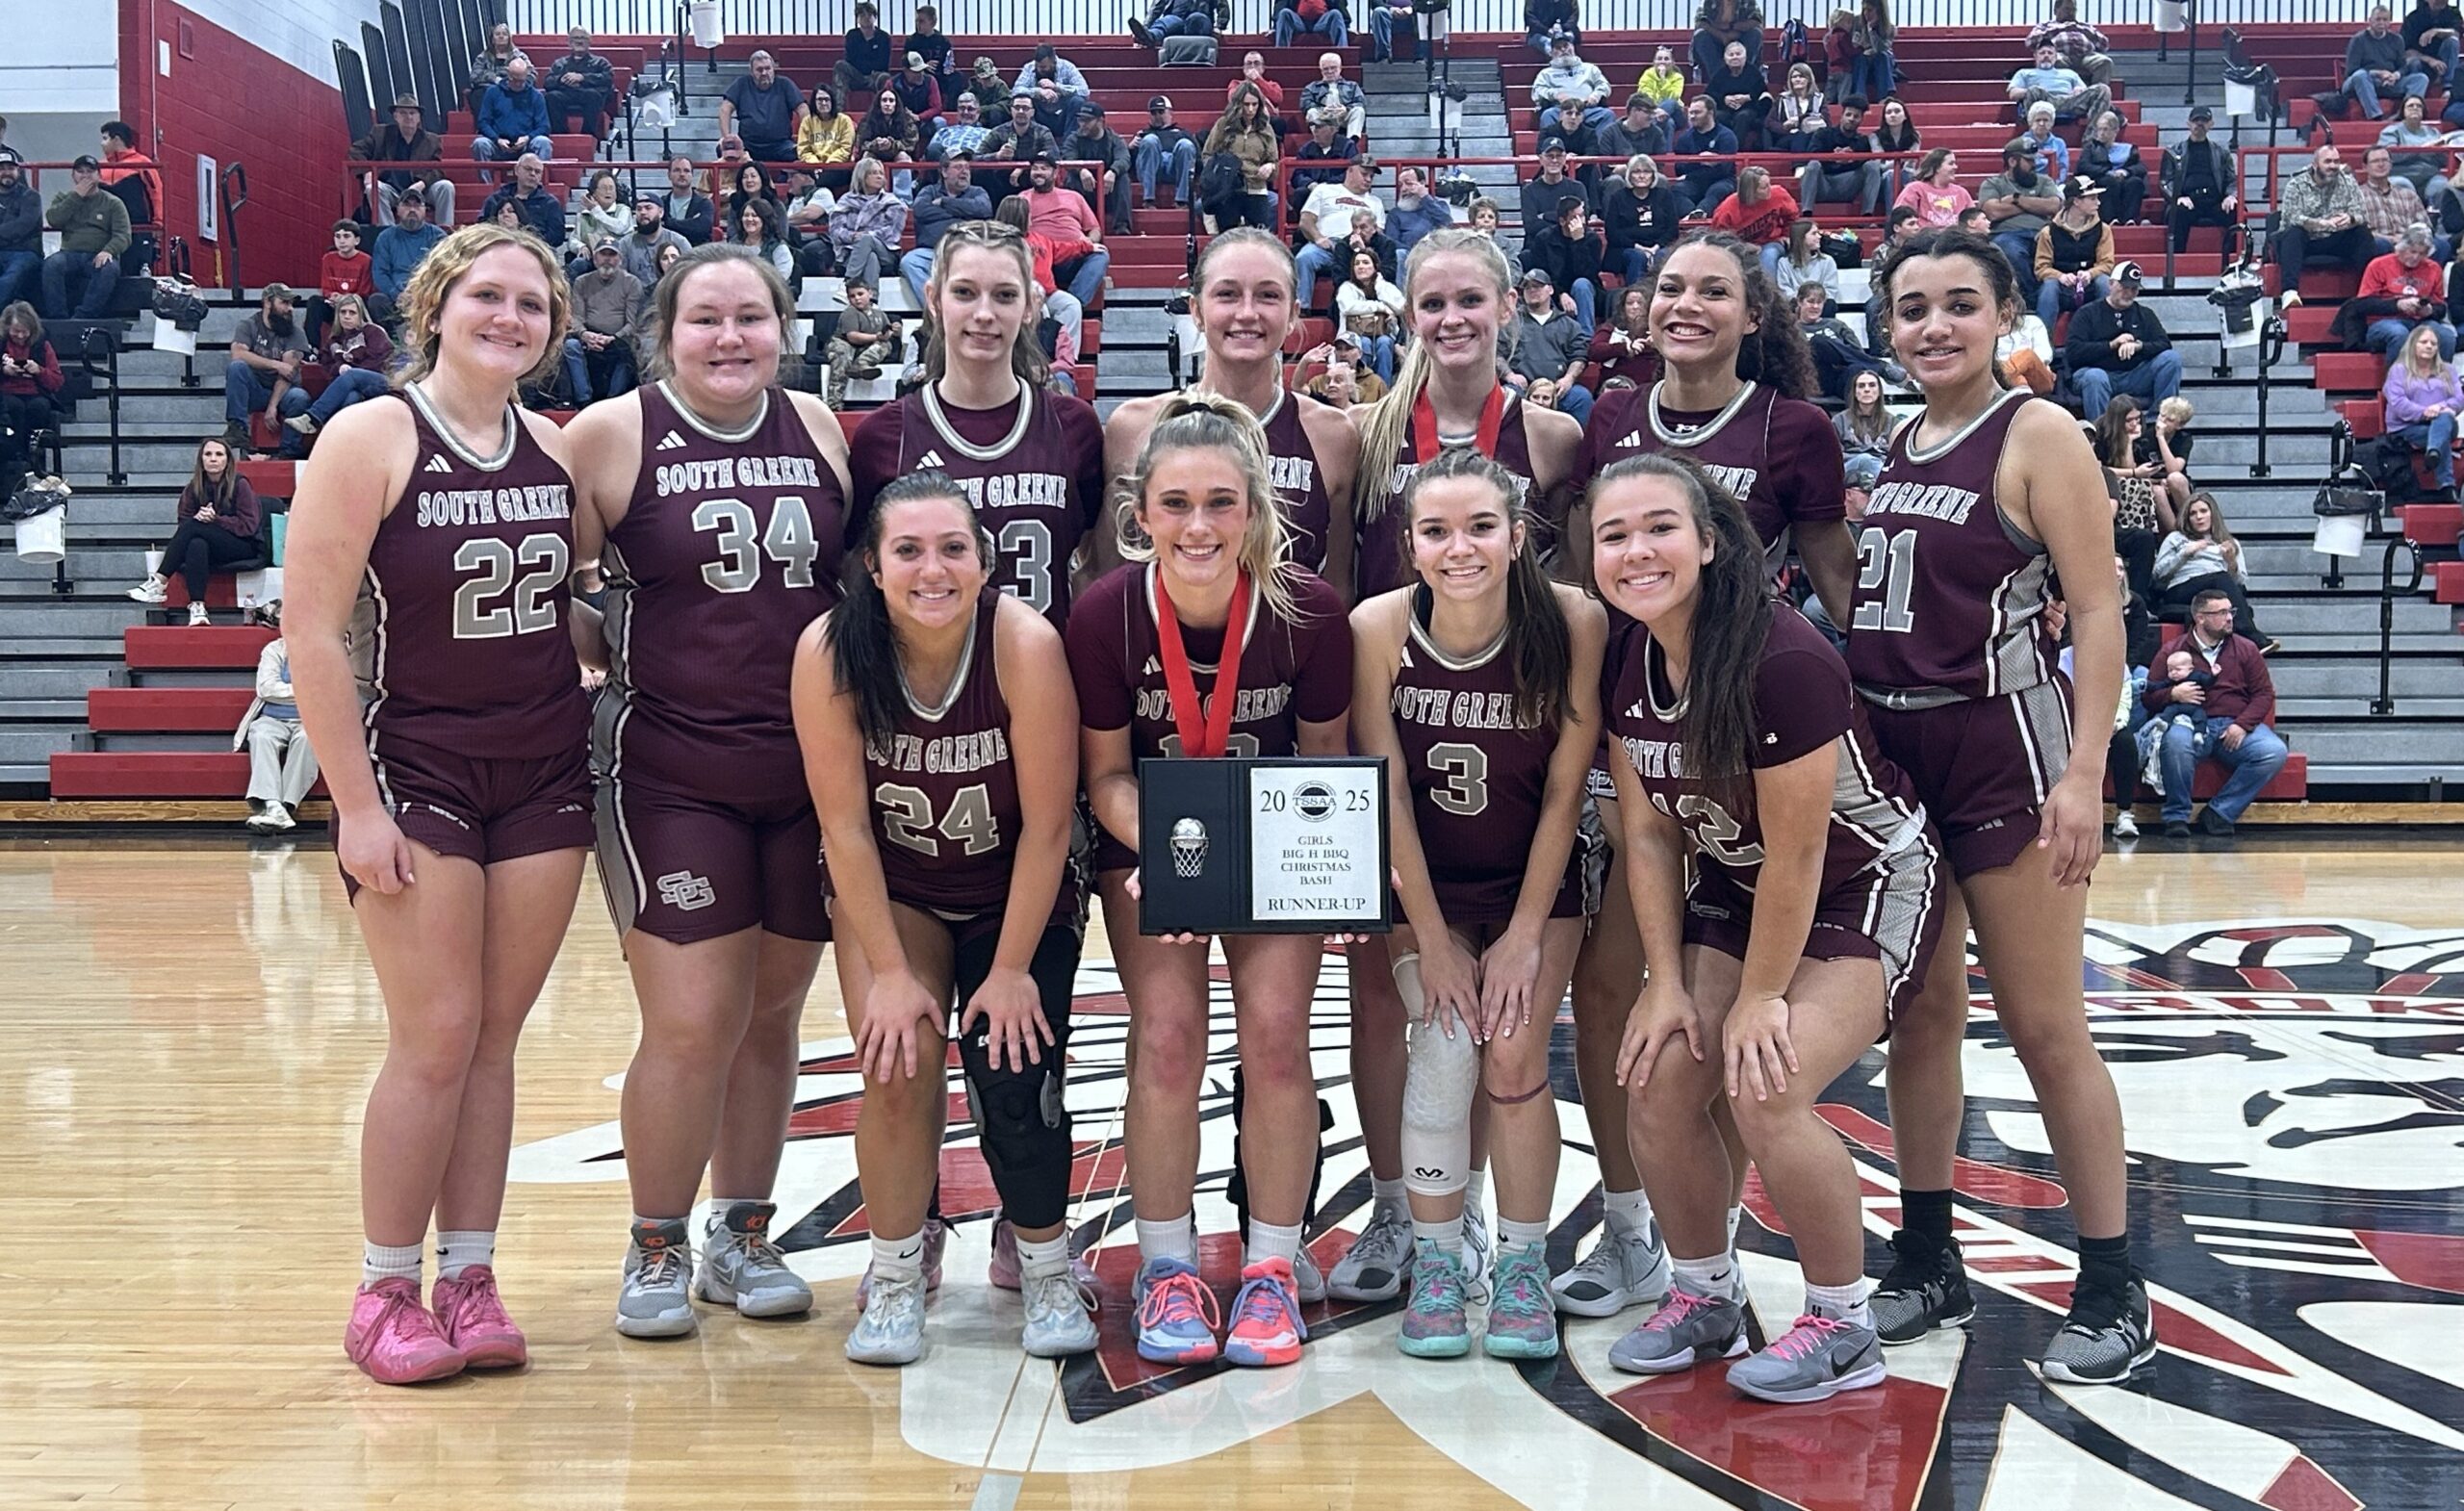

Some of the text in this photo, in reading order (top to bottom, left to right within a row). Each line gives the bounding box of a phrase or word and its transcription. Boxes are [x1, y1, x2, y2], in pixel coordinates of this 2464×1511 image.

[656, 455, 821, 497] SOUTH GREENE
[988, 473, 1066, 509] GREENE
[417, 491, 497, 527] SOUTH
[1889, 481, 1981, 525] GREENE
[692, 496, 819, 594] 34
[453, 532, 569, 640] 22
[1852, 526, 1918, 634] 21
[925, 728, 1009, 774] GREENE
[1426, 741, 1488, 816] 3
[875, 781, 1000, 858] 24
[1260, 789, 1285, 812] 20
[1345, 789, 1370, 812] 25
[1282, 849, 1349, 859] BIG H BBQ
[1297, 835, 1333, 846] GIRLS
[1280, 862, 1351, 872] CHRISTMAS
[1299, 876, 1332, 885] BASH
[1268, 897, 1366, 911] RUNNER-UP
